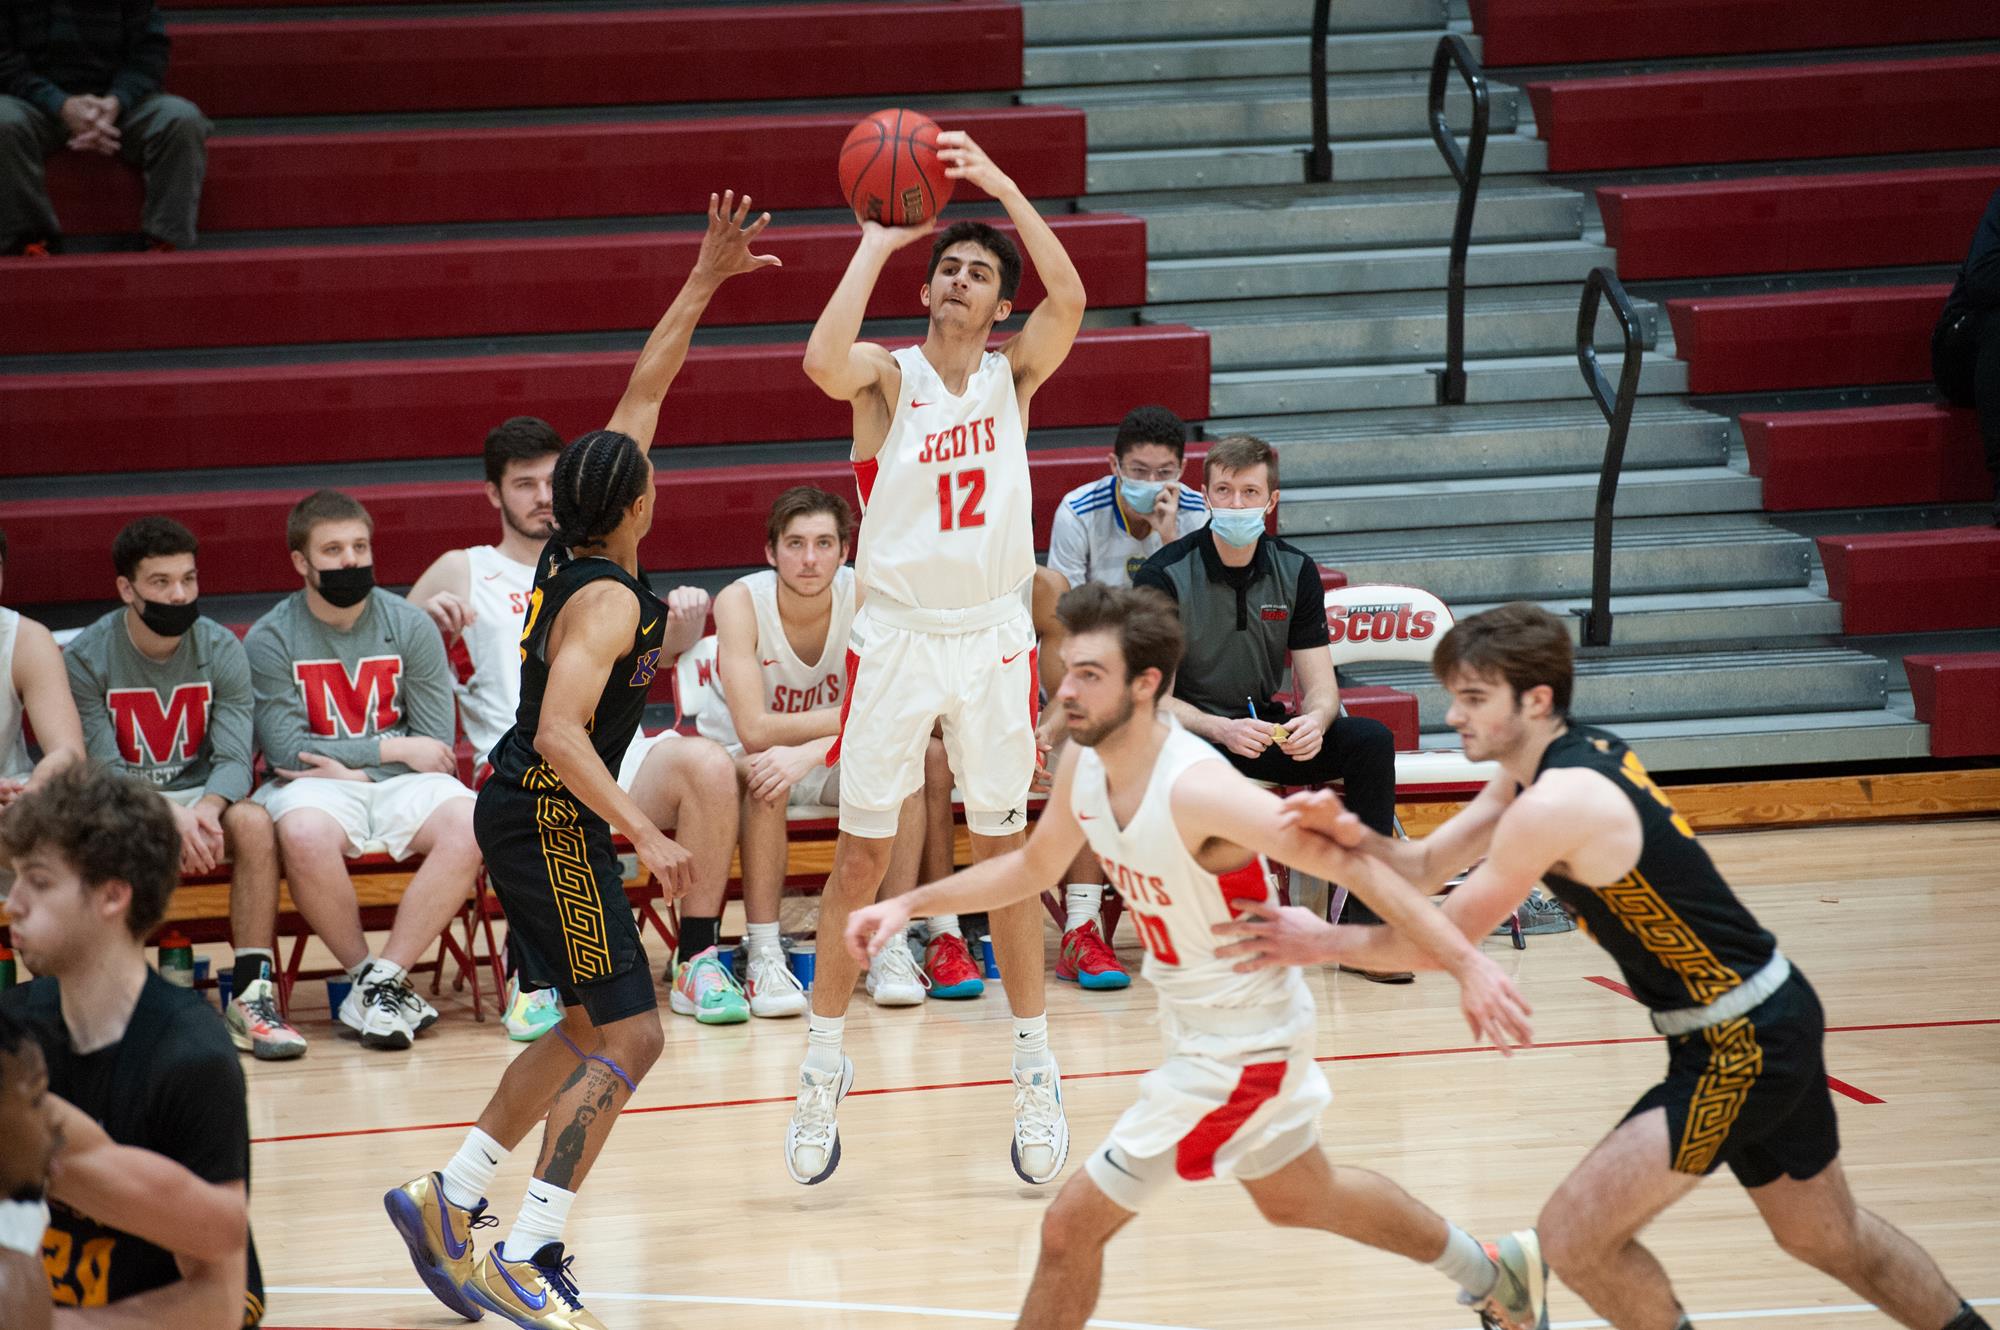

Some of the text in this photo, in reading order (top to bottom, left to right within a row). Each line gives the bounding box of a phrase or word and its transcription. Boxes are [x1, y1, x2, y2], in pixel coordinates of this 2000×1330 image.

[918, 416, 995, 463] SCOTS
[938, 467, 986, 532] 12
[1350, 604, 1399, 613] FIGHTING
[629, 647, 662, 687] K
[292, 655, 403, 740] M
[771, 673, 840, 714] SCOTS
[106, 681, 212, 766] M
